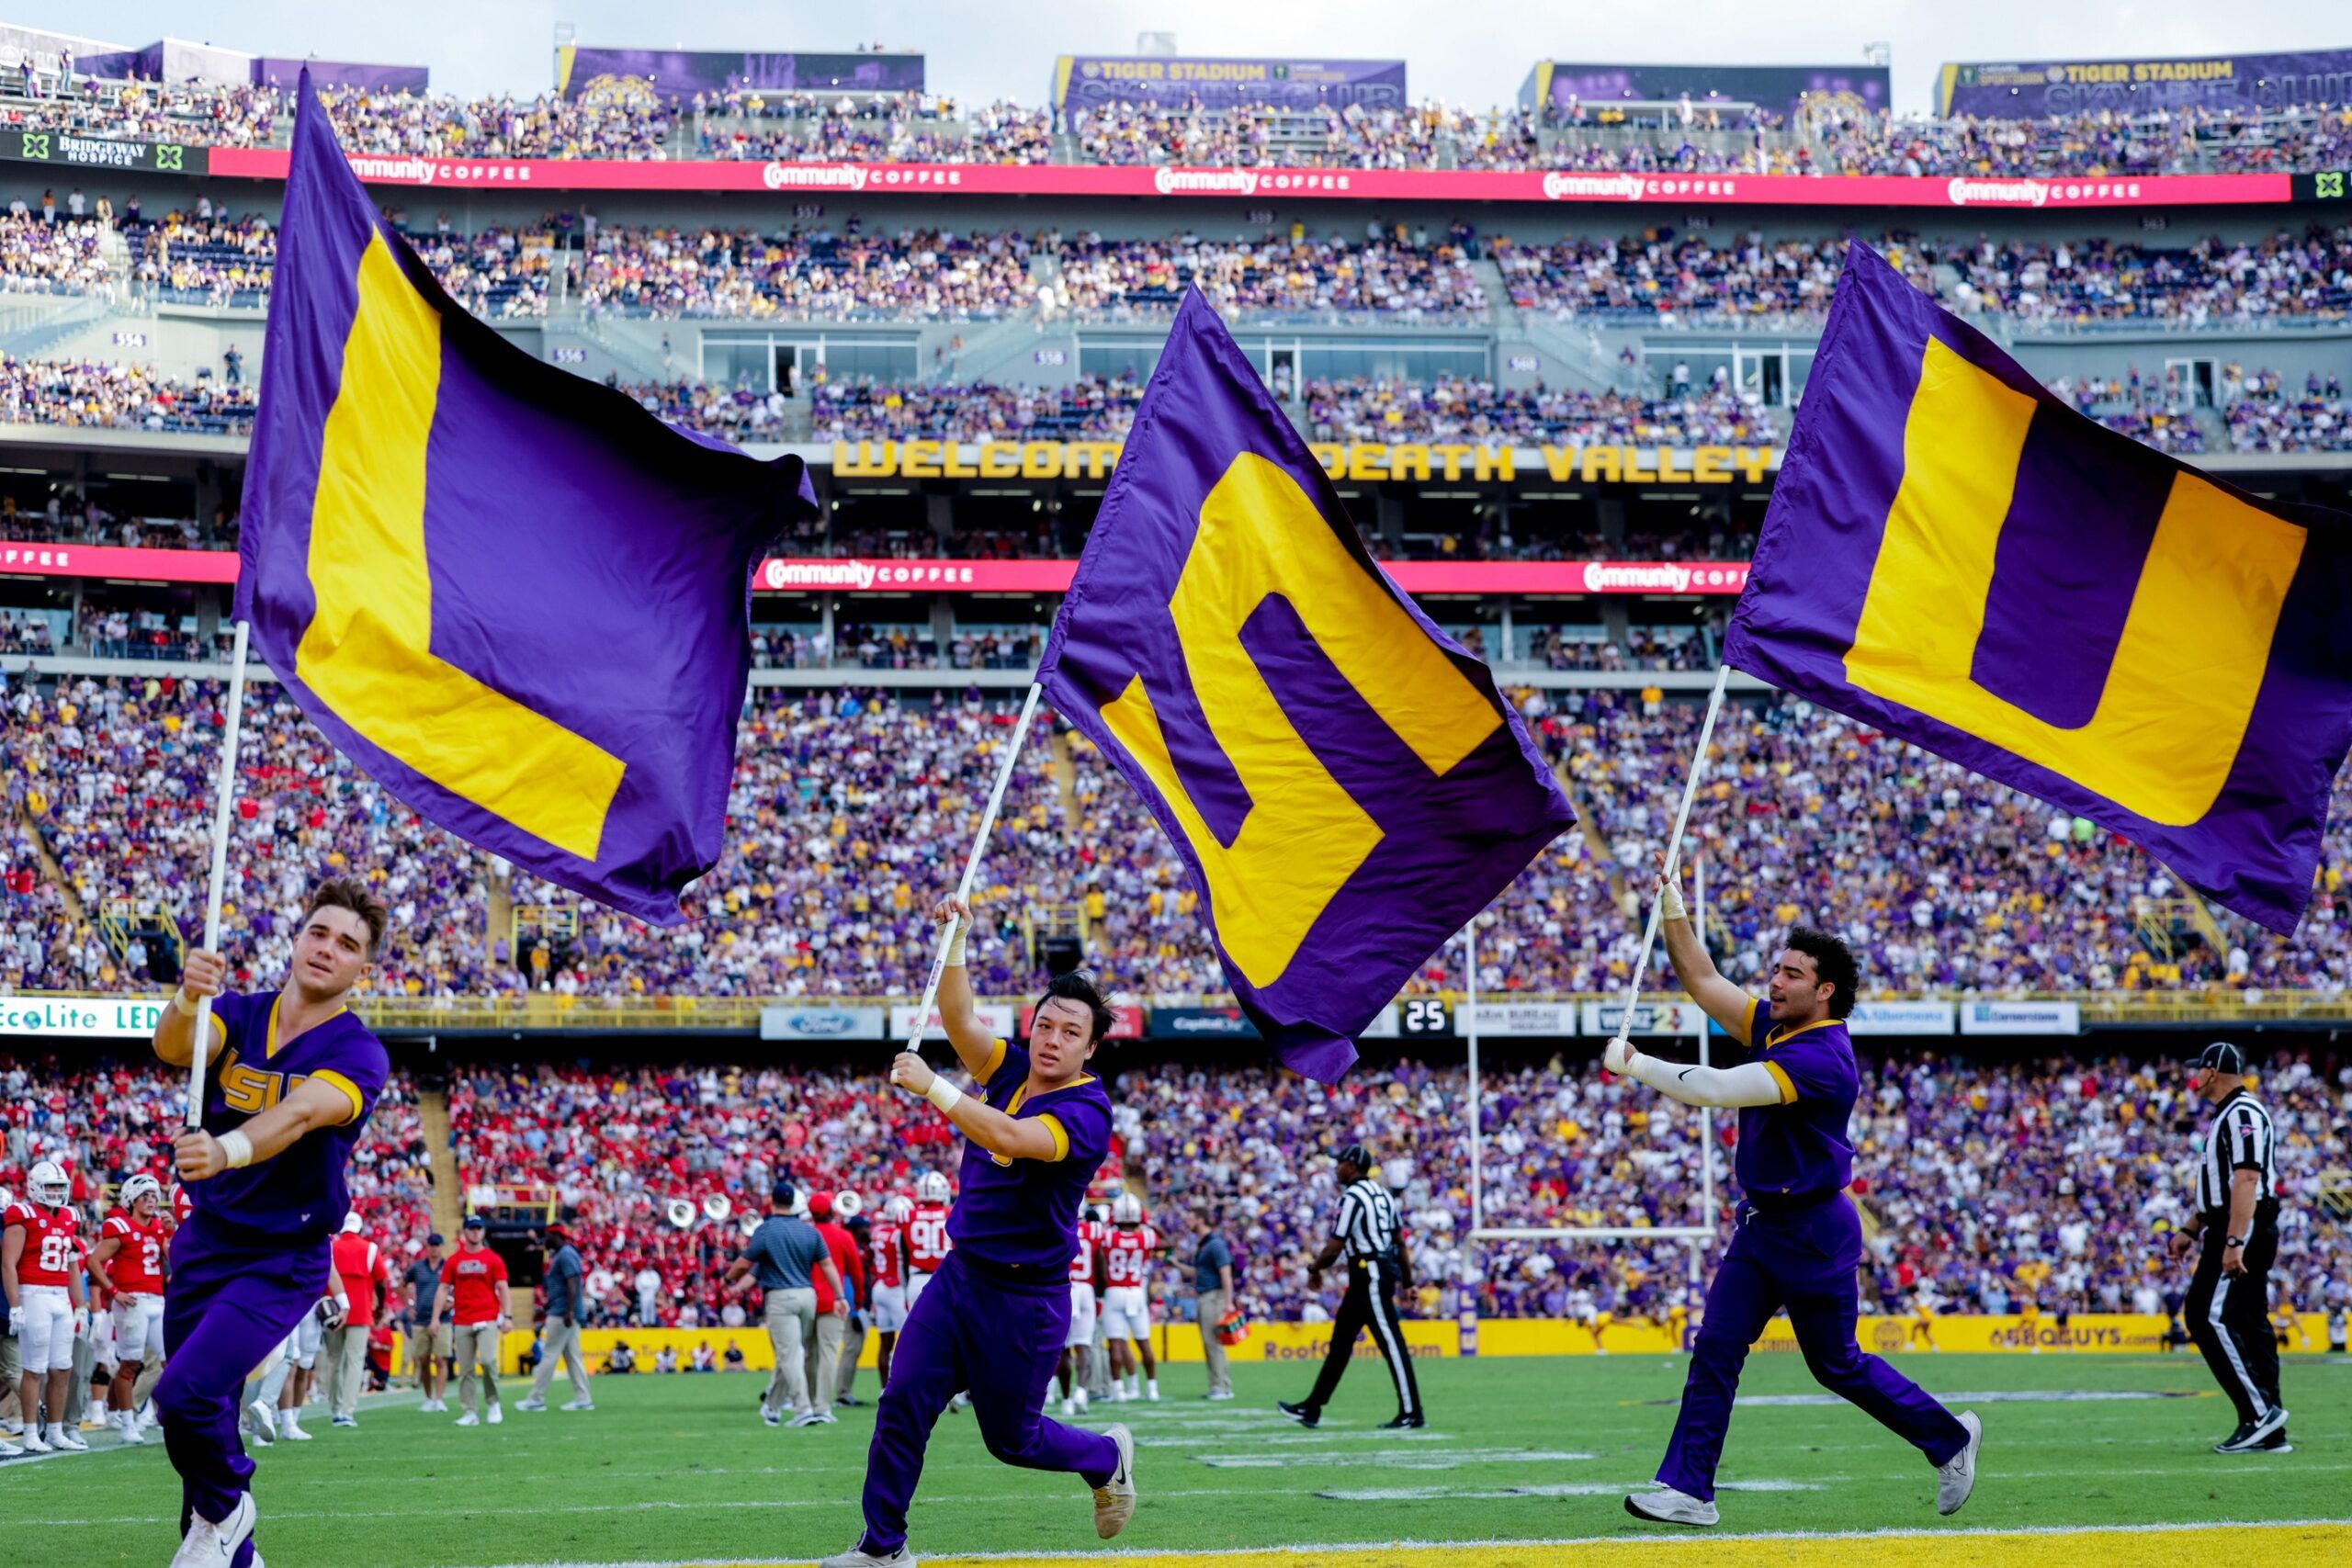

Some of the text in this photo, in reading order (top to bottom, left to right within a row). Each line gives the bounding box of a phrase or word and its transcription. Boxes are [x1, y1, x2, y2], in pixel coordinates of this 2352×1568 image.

[1102, 62, 1265, 81] TIGER STADIUM
[2066, 61, 2233, 83] TIGER STADIUM
[59, 135, 147, 157] BRIDGEWAY
[67, 152, 133, 166] HOSPICE
[349, 157, 531, 184] mmunity COFFEE
[763, 162, 961, 190] Community COFFEE
[1155, 166, 1351, 195] Community COFFEE
[1543, 171, 1736, 200] Community COFFEE
[1948, 177, 2141, 207] Community COFFEE
[832, 440, 1771, 484] WELCOM DEATH VALLEY
[296, 220, 627, 862] L
[0, 549, 69, 567] FFEE
[765, 559, 973, 590] Community COFFEE
[1584, 561, 1690, 592] Community
[1842, 333, 2309, 827] U
[1100, 450, 1504, 990] S
[1407, 1000, 1445, 1031] 25
[1374, 1196, 1389, 1230] S
[40, 1235, 72, 1272] 81
[910, 1220, 953, 1259] 90
[142, 1243, 161, 1276] 2
[1108, 1248, 1144, 1281] 84
